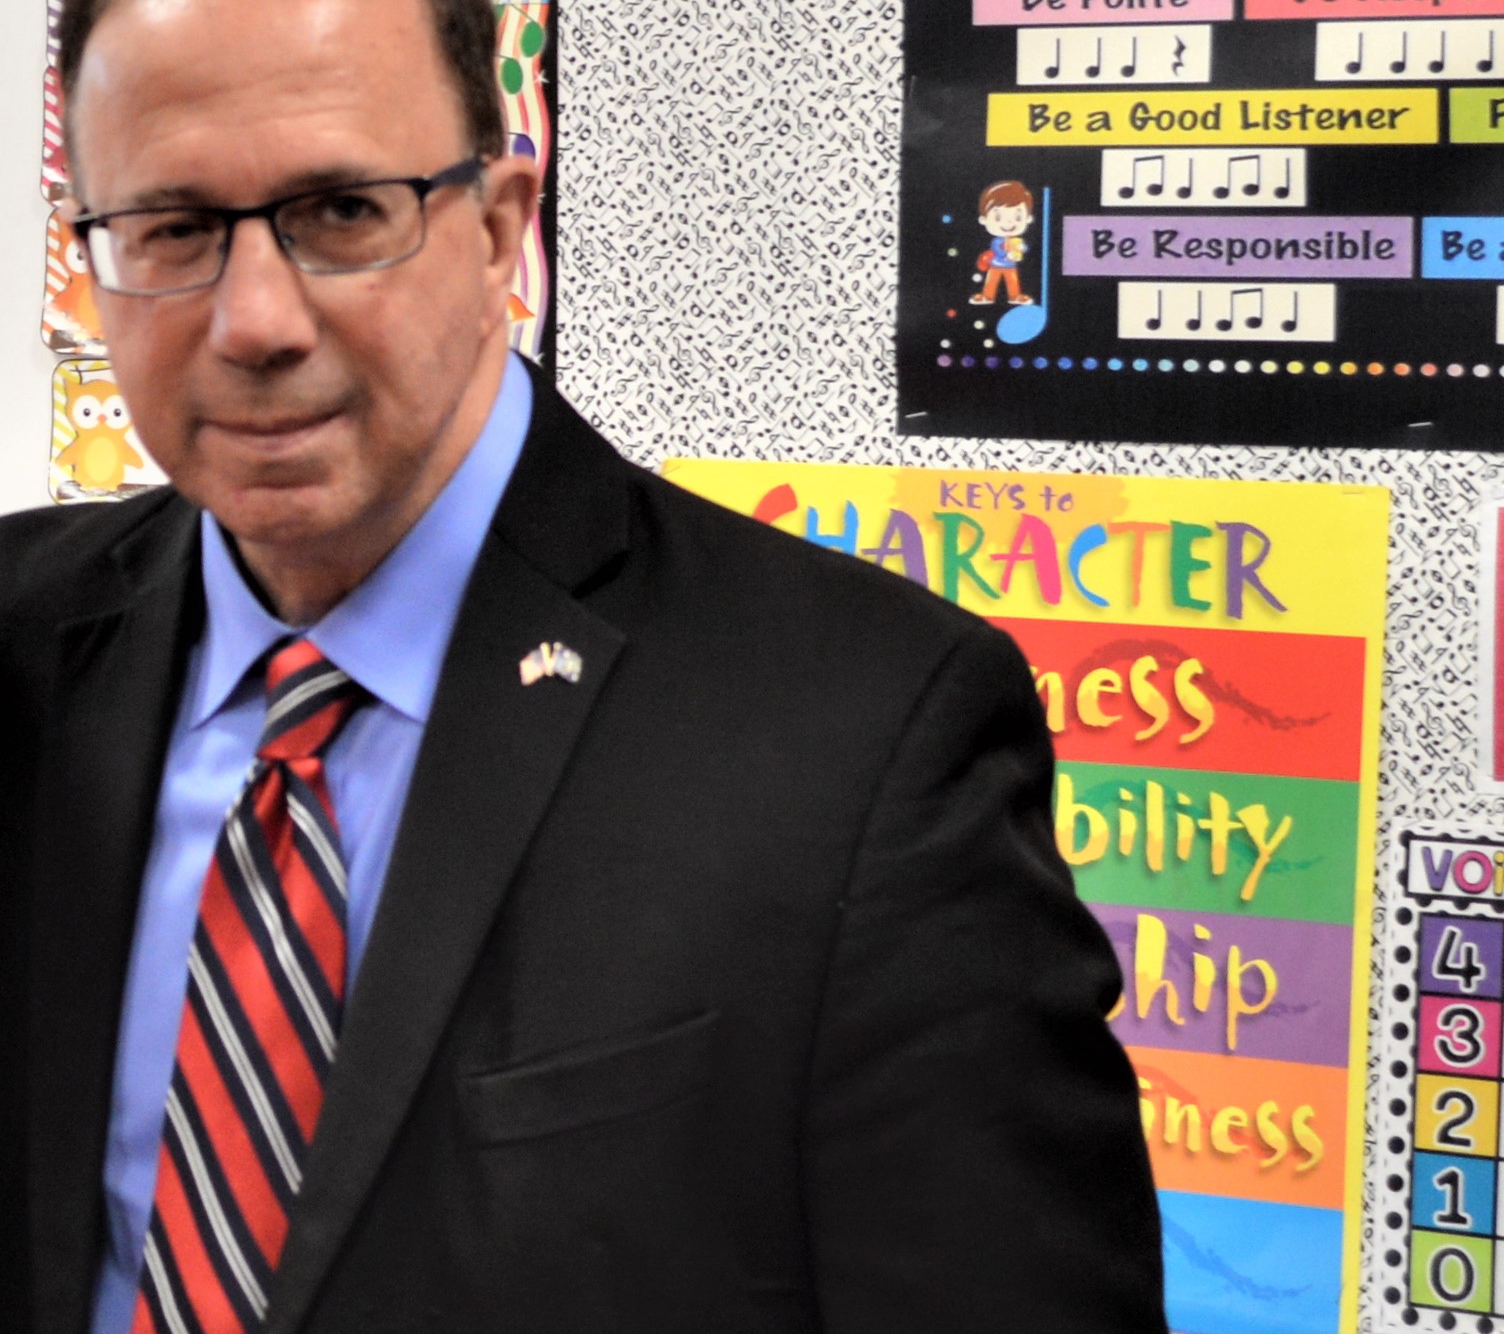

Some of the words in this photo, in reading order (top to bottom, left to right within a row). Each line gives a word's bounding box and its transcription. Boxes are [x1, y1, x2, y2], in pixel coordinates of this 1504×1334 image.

[1028, 103, 1073, 133] Be
[1085, 109, 1112, 132] a
[1128, 101, 1223, 132] Good
[1238, 99, 1410, 130] Listener
[1090, 228, 1146, 260] Be
[1152, 228, 1396, 268] Responsible
[1440, 232, 1488, 262] Be
[939, 478, 1026, 511] KEYS
[1039, 485, 1075, 512] to
[1434, 927, 1484, 989] 4
[1436, 1007, 1483, 1065] 3
[1435, 1090, 1474, 1148] 2
[1434, 1169, 1470, 1226] 1
[1429, 1247, 1474, 1303] 0
